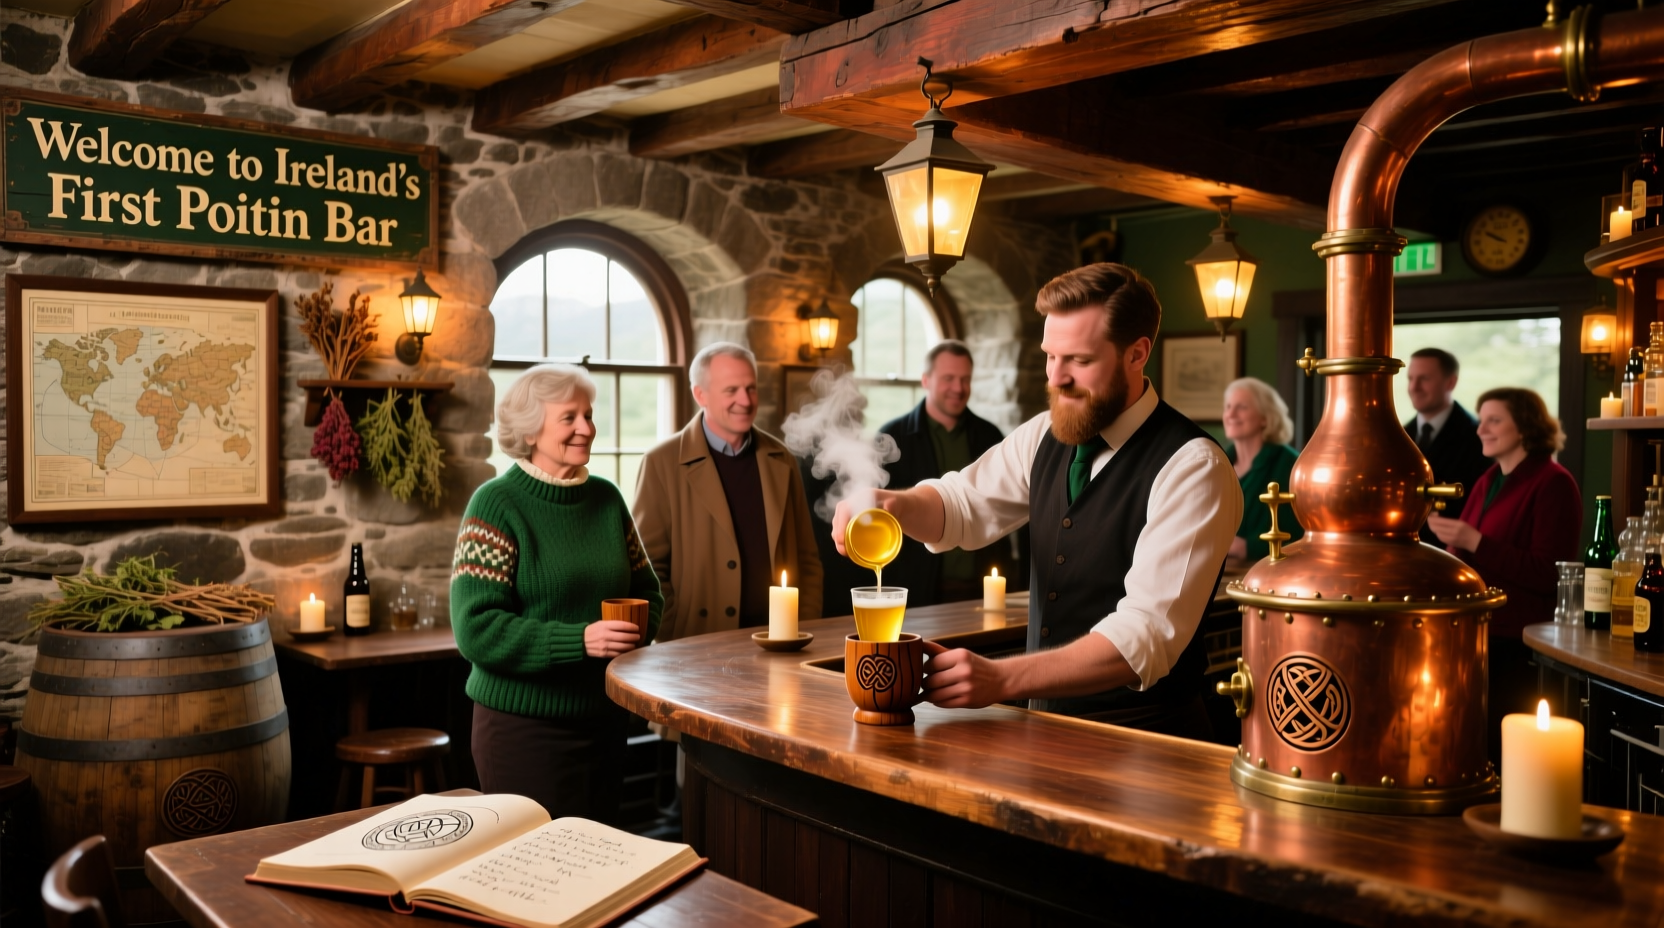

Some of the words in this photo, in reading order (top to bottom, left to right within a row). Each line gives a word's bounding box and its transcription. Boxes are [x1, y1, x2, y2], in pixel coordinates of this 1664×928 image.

[27, 117, 214, 176] Welcome
[227, 148, 263, 181] to
[274, 147, 421, 200] Ireland's
[47, 172, 161, 227] First
[176, 185, 311, 241] Poitin
[323, 200, 398, 247] Bar
